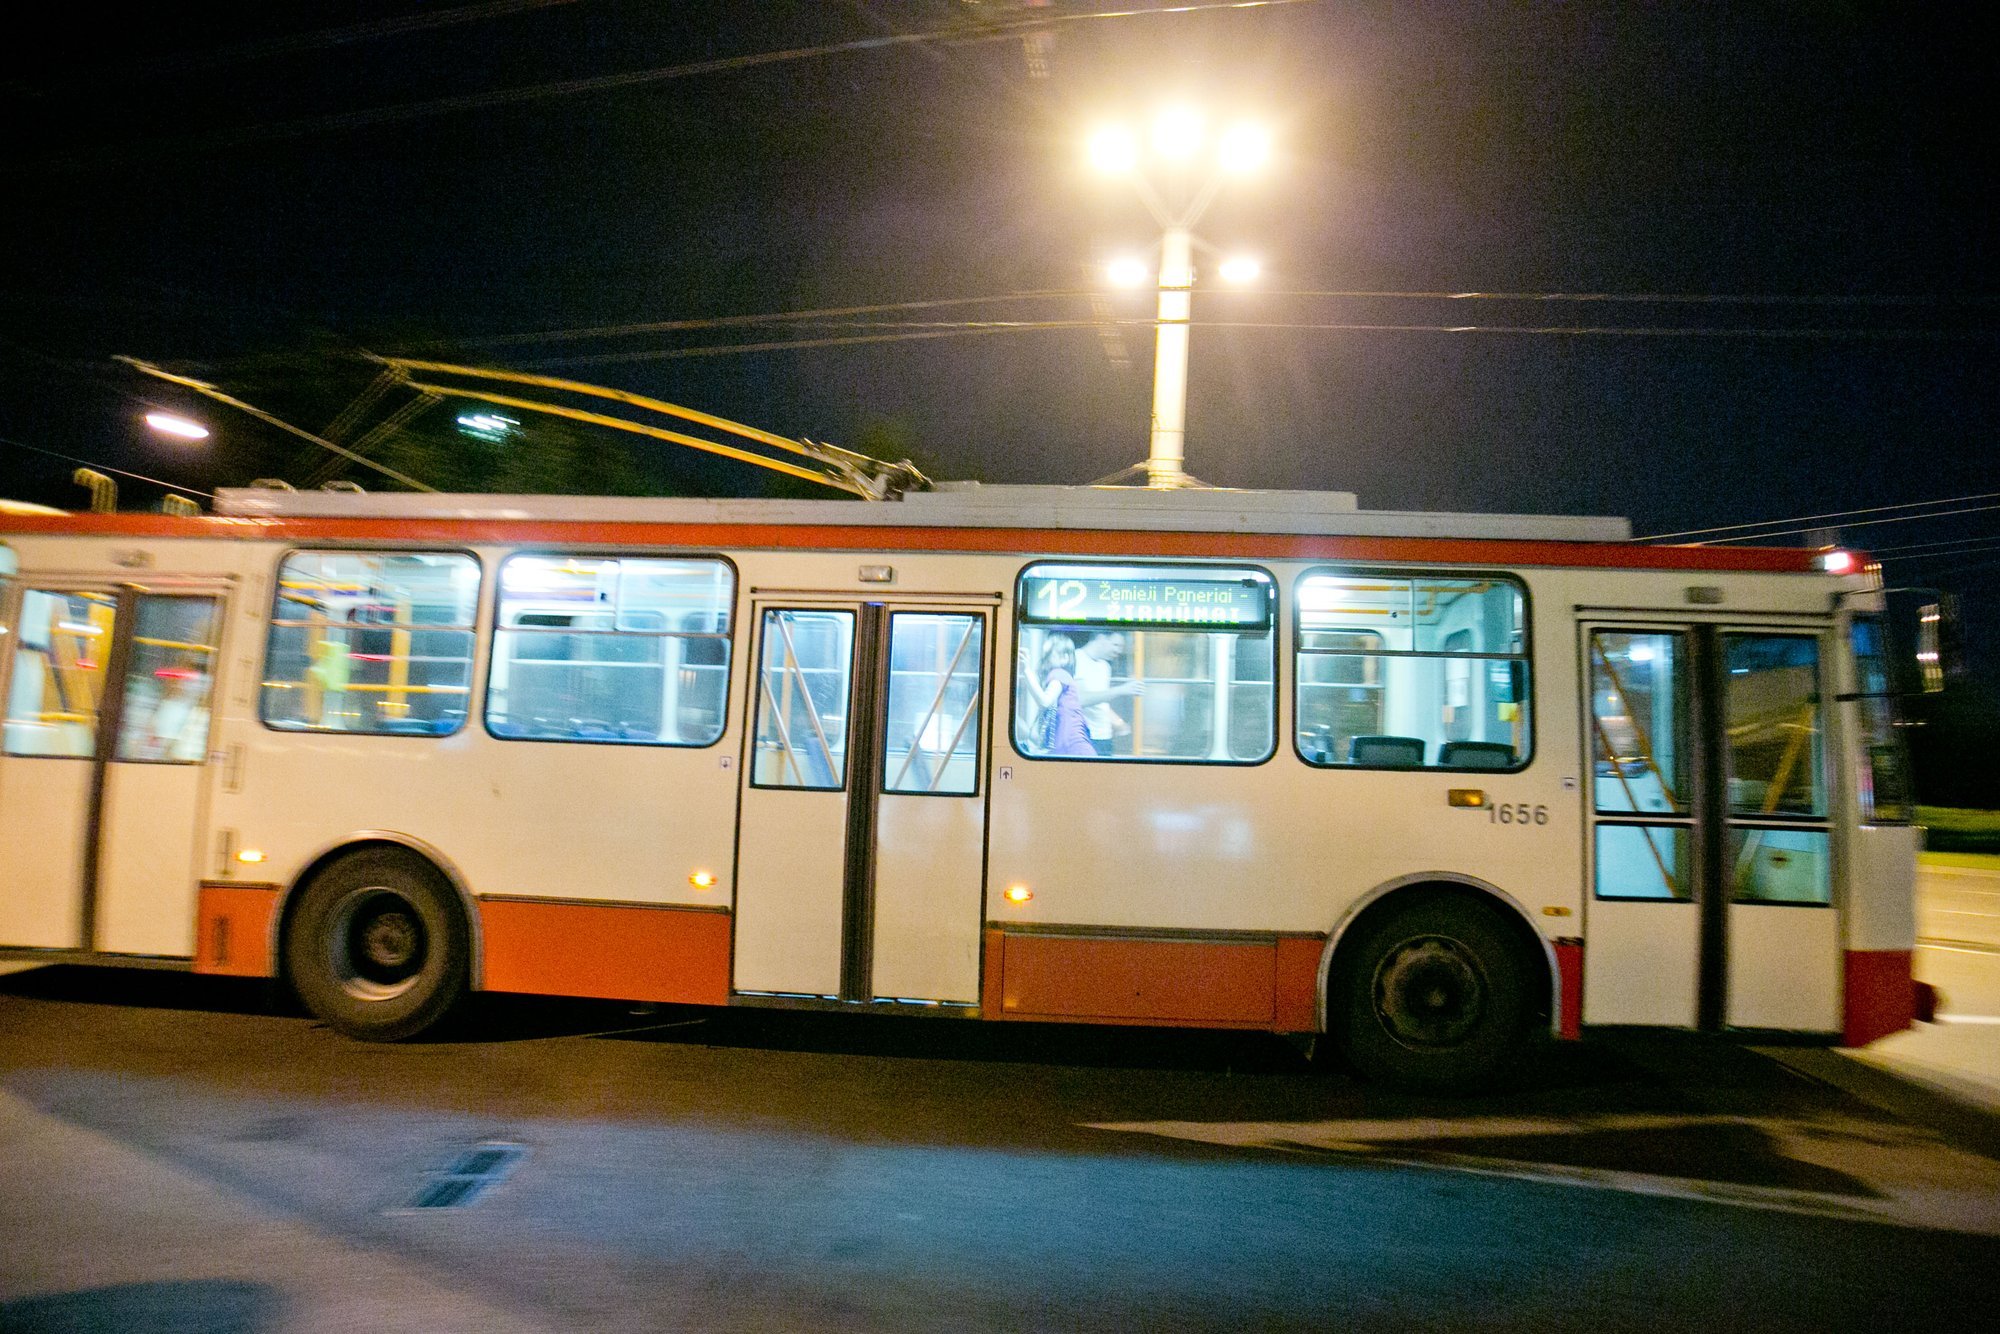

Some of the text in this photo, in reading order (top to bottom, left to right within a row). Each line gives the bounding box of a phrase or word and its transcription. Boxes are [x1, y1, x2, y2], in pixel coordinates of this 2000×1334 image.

[1037, 580, 1087, 621] 12
[1099, 581, 1157, 602] Žemieji
[1164, 586, 1233, 604] Paneriai
[1489, 803, 1548, 825] 1656
